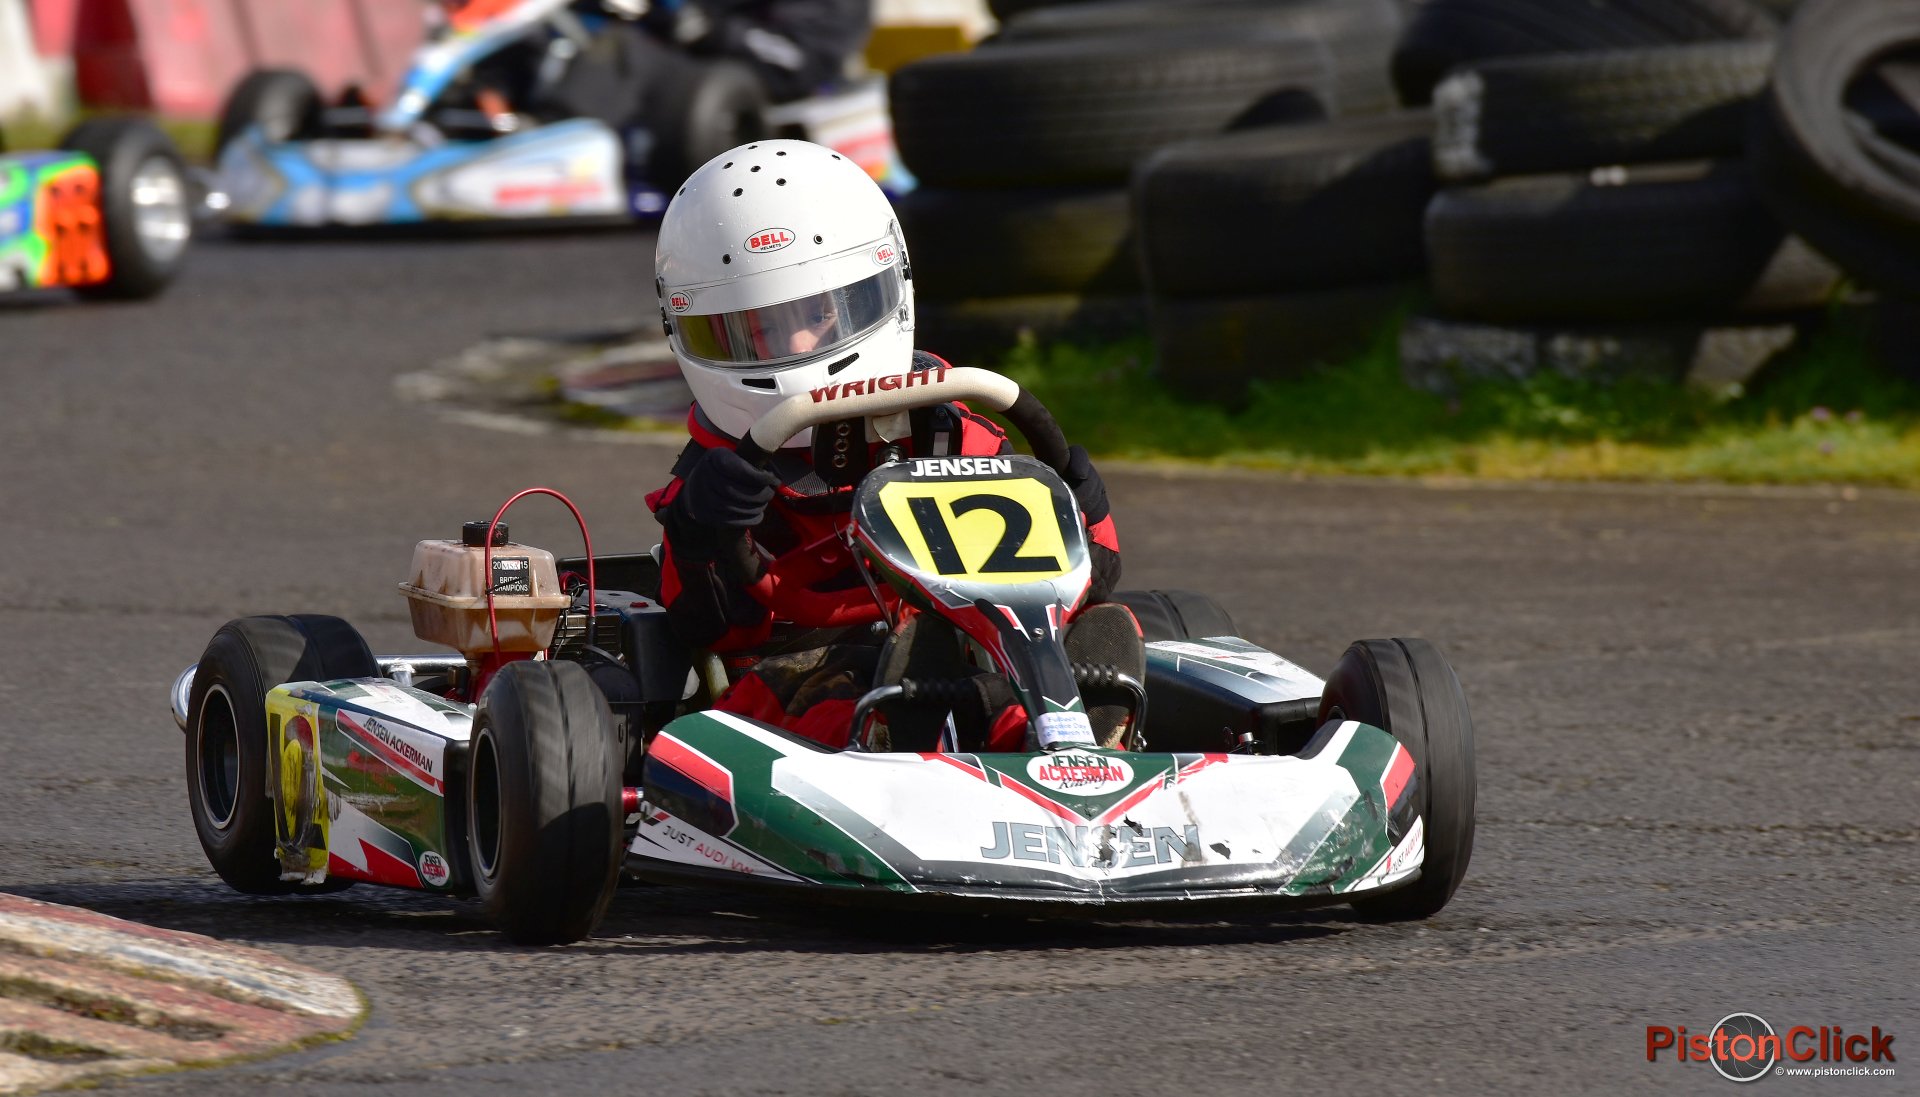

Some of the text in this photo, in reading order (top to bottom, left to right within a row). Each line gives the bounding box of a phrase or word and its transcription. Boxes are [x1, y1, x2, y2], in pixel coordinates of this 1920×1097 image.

[749, 232, 792, 249] BELL
[876, 247, 894, 261] BELL
[671, 297, 689, 307] BELL
[809, 367, 953, 403] WRIGHT
[910, 458, 1013, 477] JENSEN
[906, 493, 1062, 576] 12
[363, 716, 433, 774] JENSEN ACKERMAN
[1047, 755, 1110, 769] JENSEN
[1039, 765, 1125, 782] ACKERMAN
[662, 825, 695, 847] JUST
[695, 842, 729, 865] AUDI
